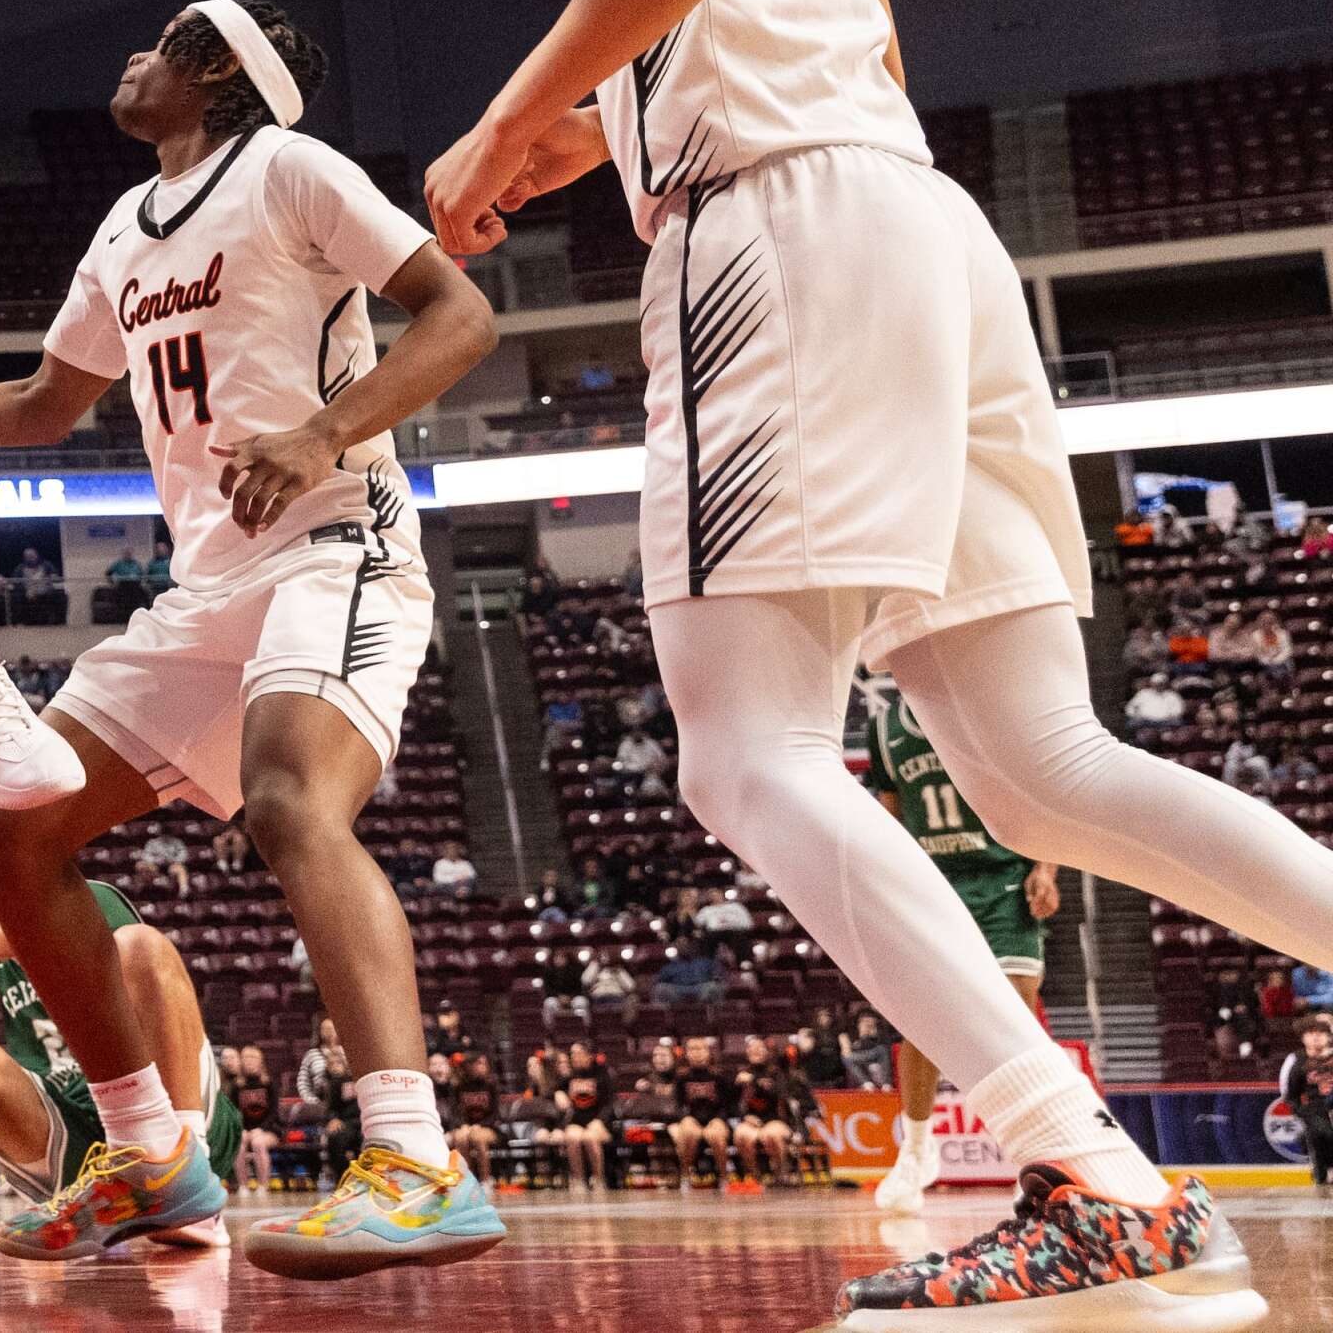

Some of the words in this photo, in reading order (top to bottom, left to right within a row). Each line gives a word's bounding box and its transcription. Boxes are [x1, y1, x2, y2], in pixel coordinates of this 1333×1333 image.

[118, 251, 225, 335] Central
[147, 330, 214, 436] 14
[921, 784, 963, 830] 11
